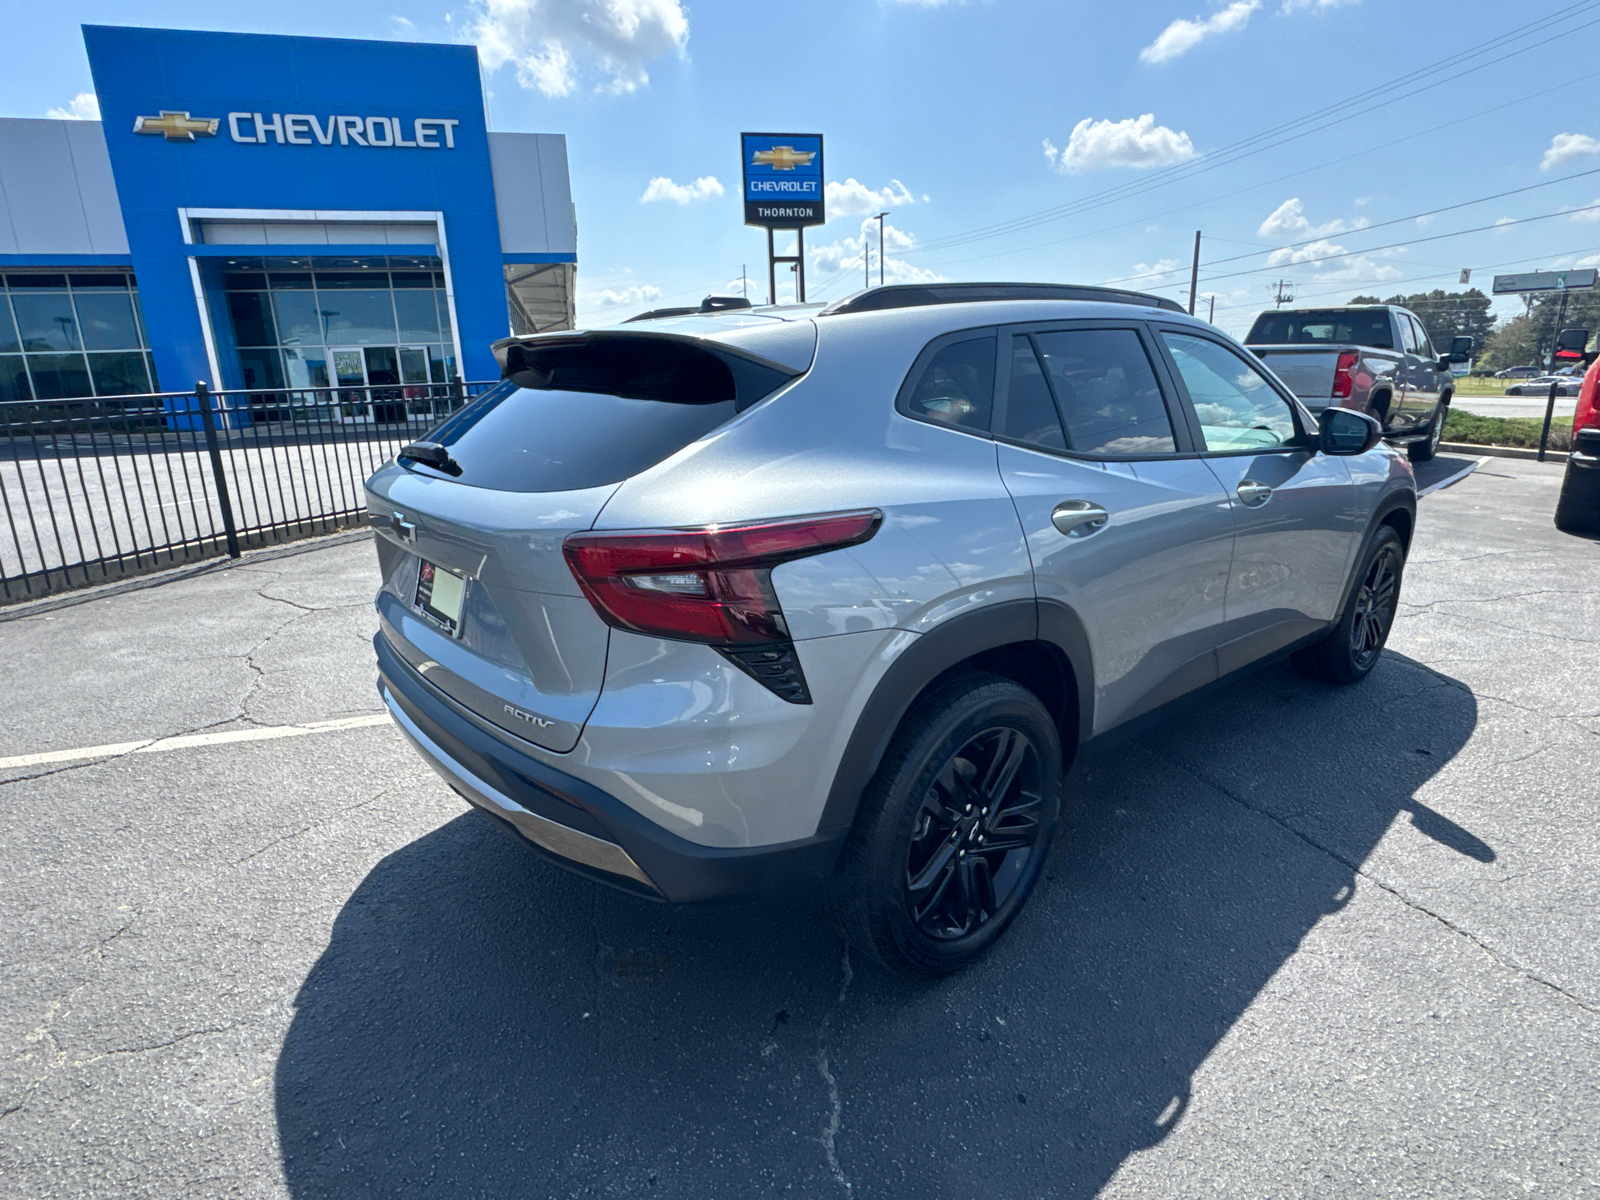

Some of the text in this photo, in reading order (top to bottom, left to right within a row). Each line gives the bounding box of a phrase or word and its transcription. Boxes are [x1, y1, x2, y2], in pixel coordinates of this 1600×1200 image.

[228, 112, 459, 148] CHEVROLET
[750, 181, 817, 192] CHEVROLET
[758, 207, 813, 217] THORNTON
[504, 704, 556, 728] ACTIV
